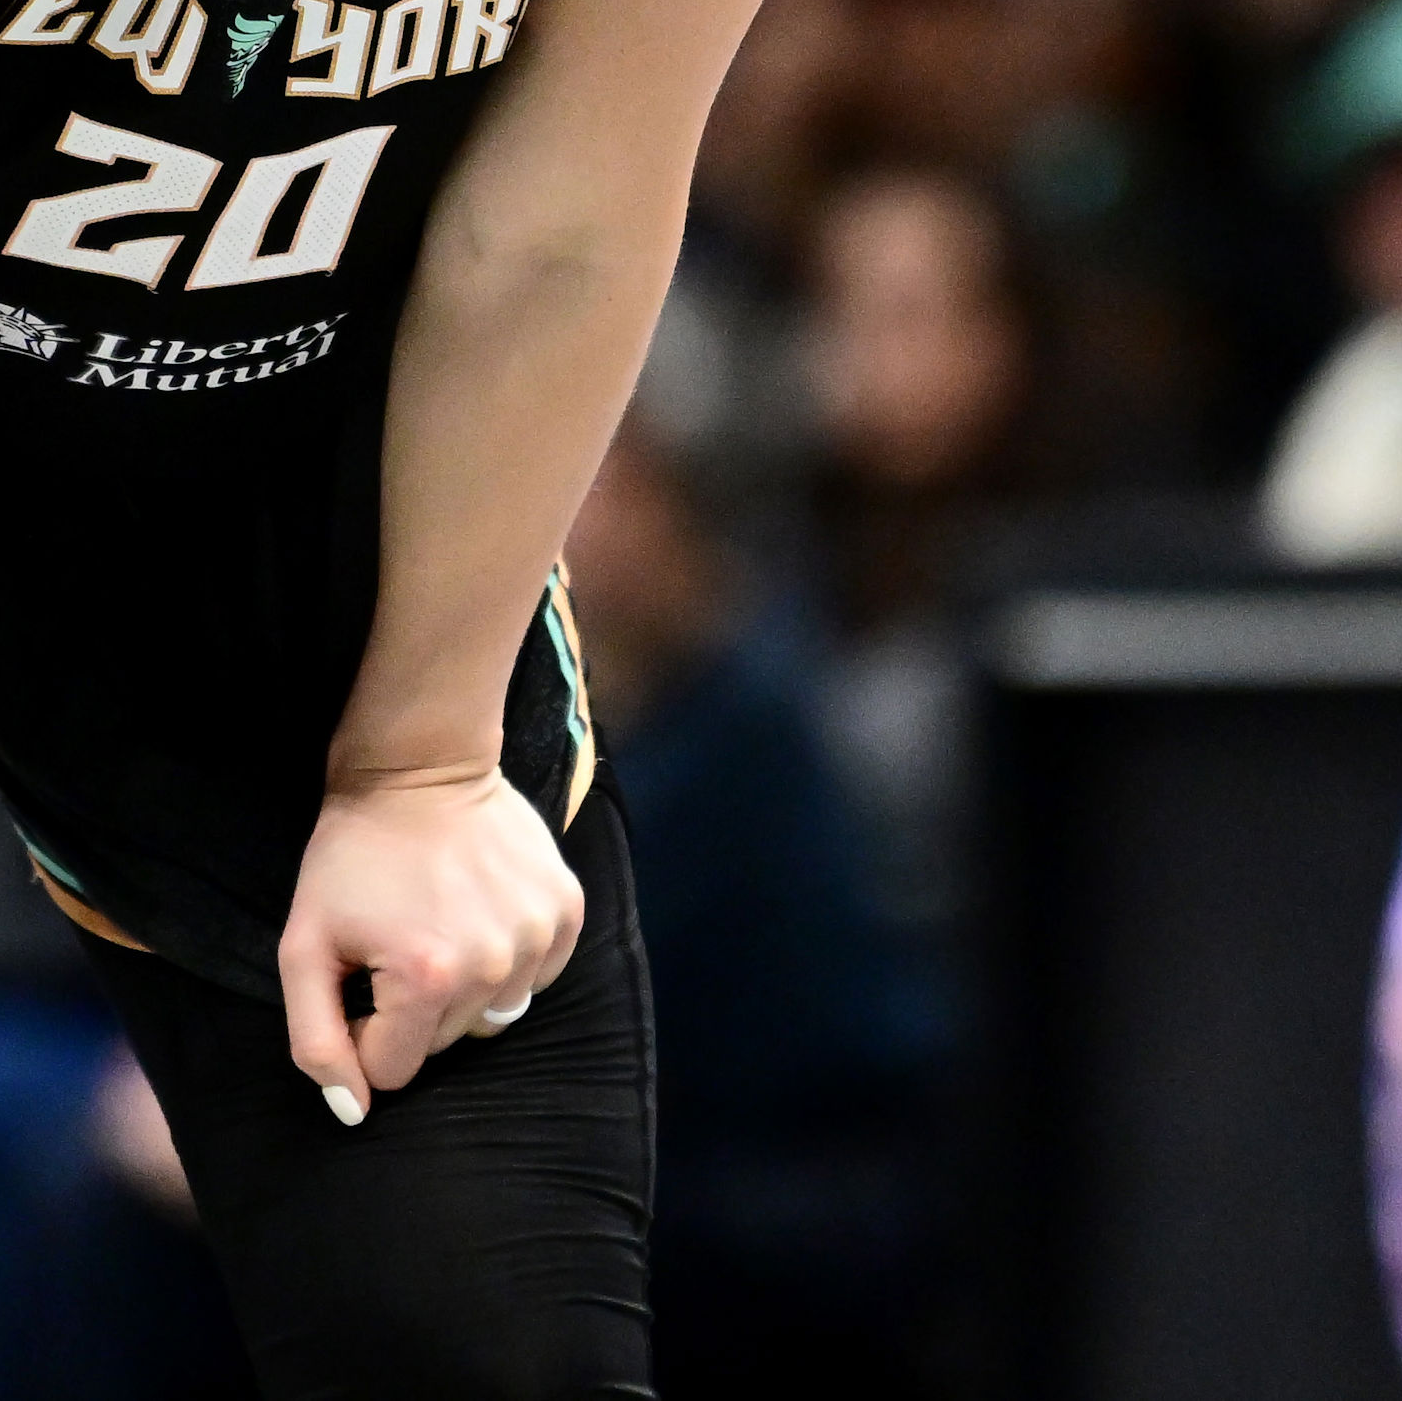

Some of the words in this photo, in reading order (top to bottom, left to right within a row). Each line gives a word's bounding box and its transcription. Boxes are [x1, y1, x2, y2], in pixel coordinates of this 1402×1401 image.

[2, 111, 397, 291] 20
[67, 331, 336, 391] Mutual
[87, 312, 349, 365] Liberty
